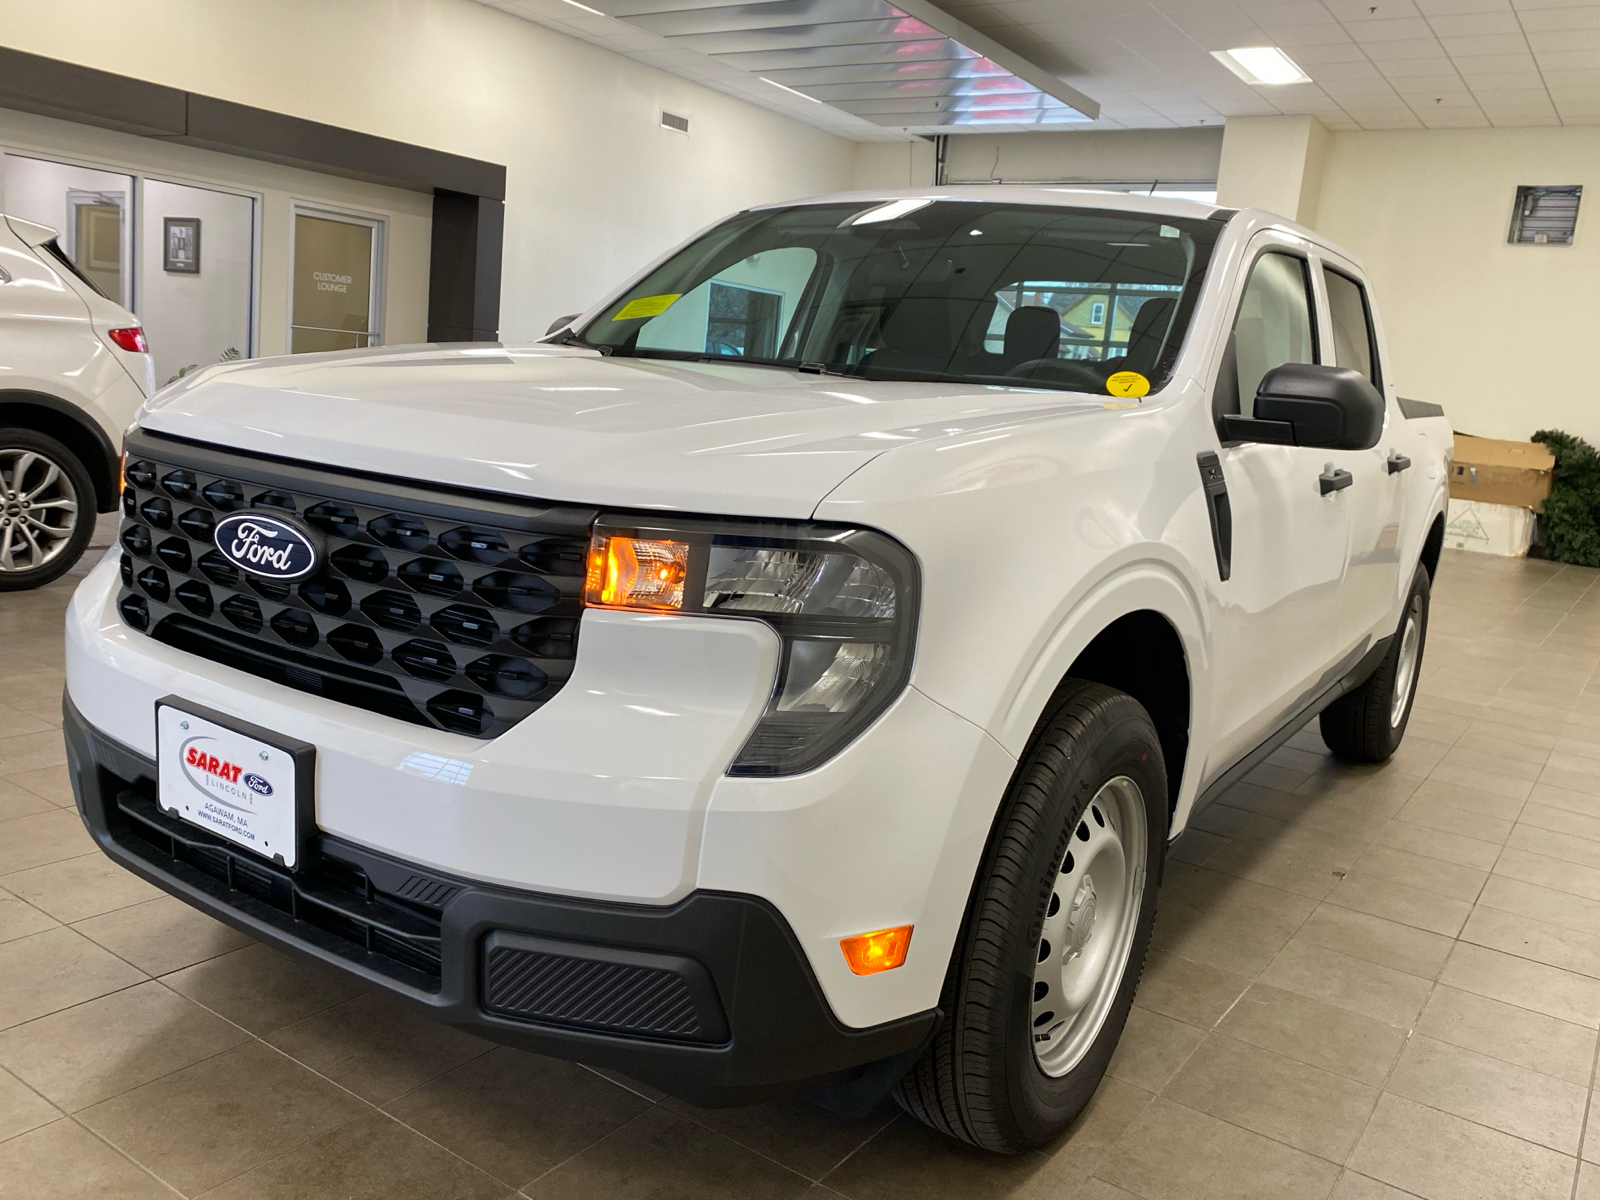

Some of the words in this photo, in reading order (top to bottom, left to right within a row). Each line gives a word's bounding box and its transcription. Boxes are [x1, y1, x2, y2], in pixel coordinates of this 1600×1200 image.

[313, 271, 352, 284] CUSTOMER
[317, 282, 347, 293] LOUNGE
[1208, 468, 1223, 479] XL
[231, 522, 293, 571] Ford
[186, 747, 243, 784] SARAT
[211, 780, 247, 800] LINCOLN
[248, 776, 269, 794] Ford
[197, 809, 256, 841] WWW.SARATFORD.COM
[204, 802, 236, 823] AGAWAM,
[237, 815, 248, 828] MA
